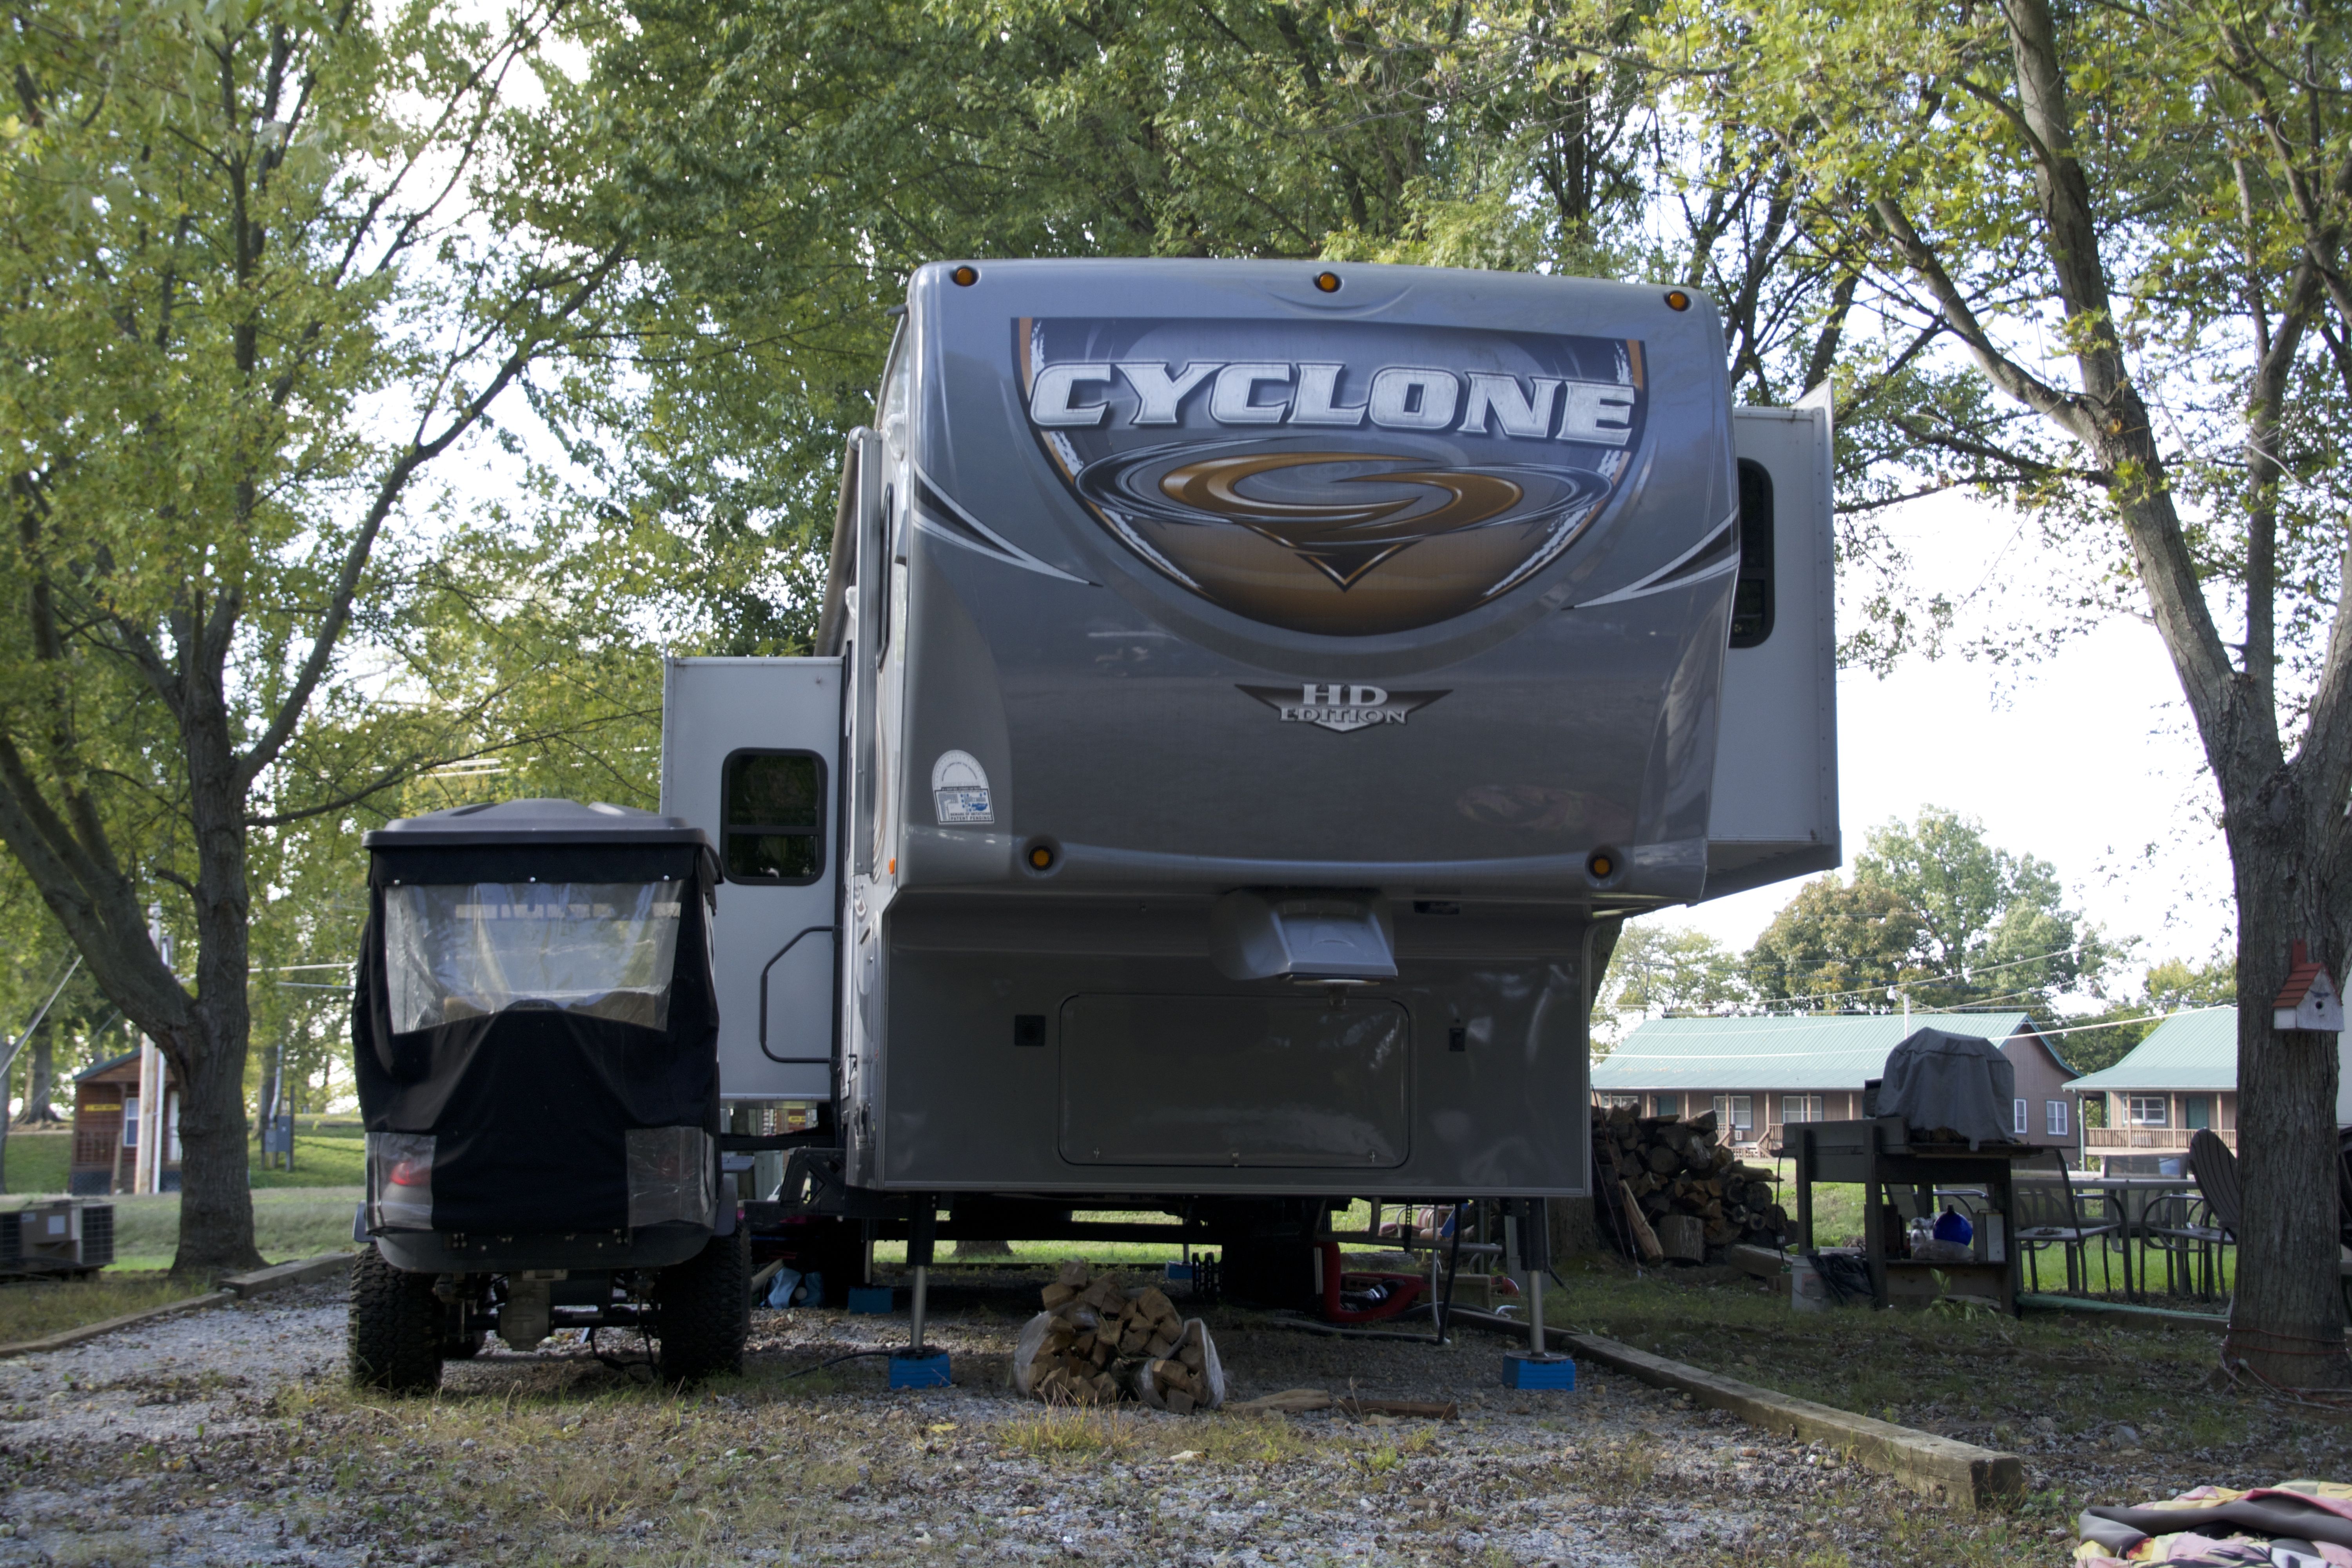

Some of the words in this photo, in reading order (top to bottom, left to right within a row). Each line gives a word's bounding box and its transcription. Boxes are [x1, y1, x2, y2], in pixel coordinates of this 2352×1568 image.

[1030, 361, 1637, 447] CYCLONE
[1302, 682, 1388, 706] HD
[1279, 708, 1408, 724] EDITION
